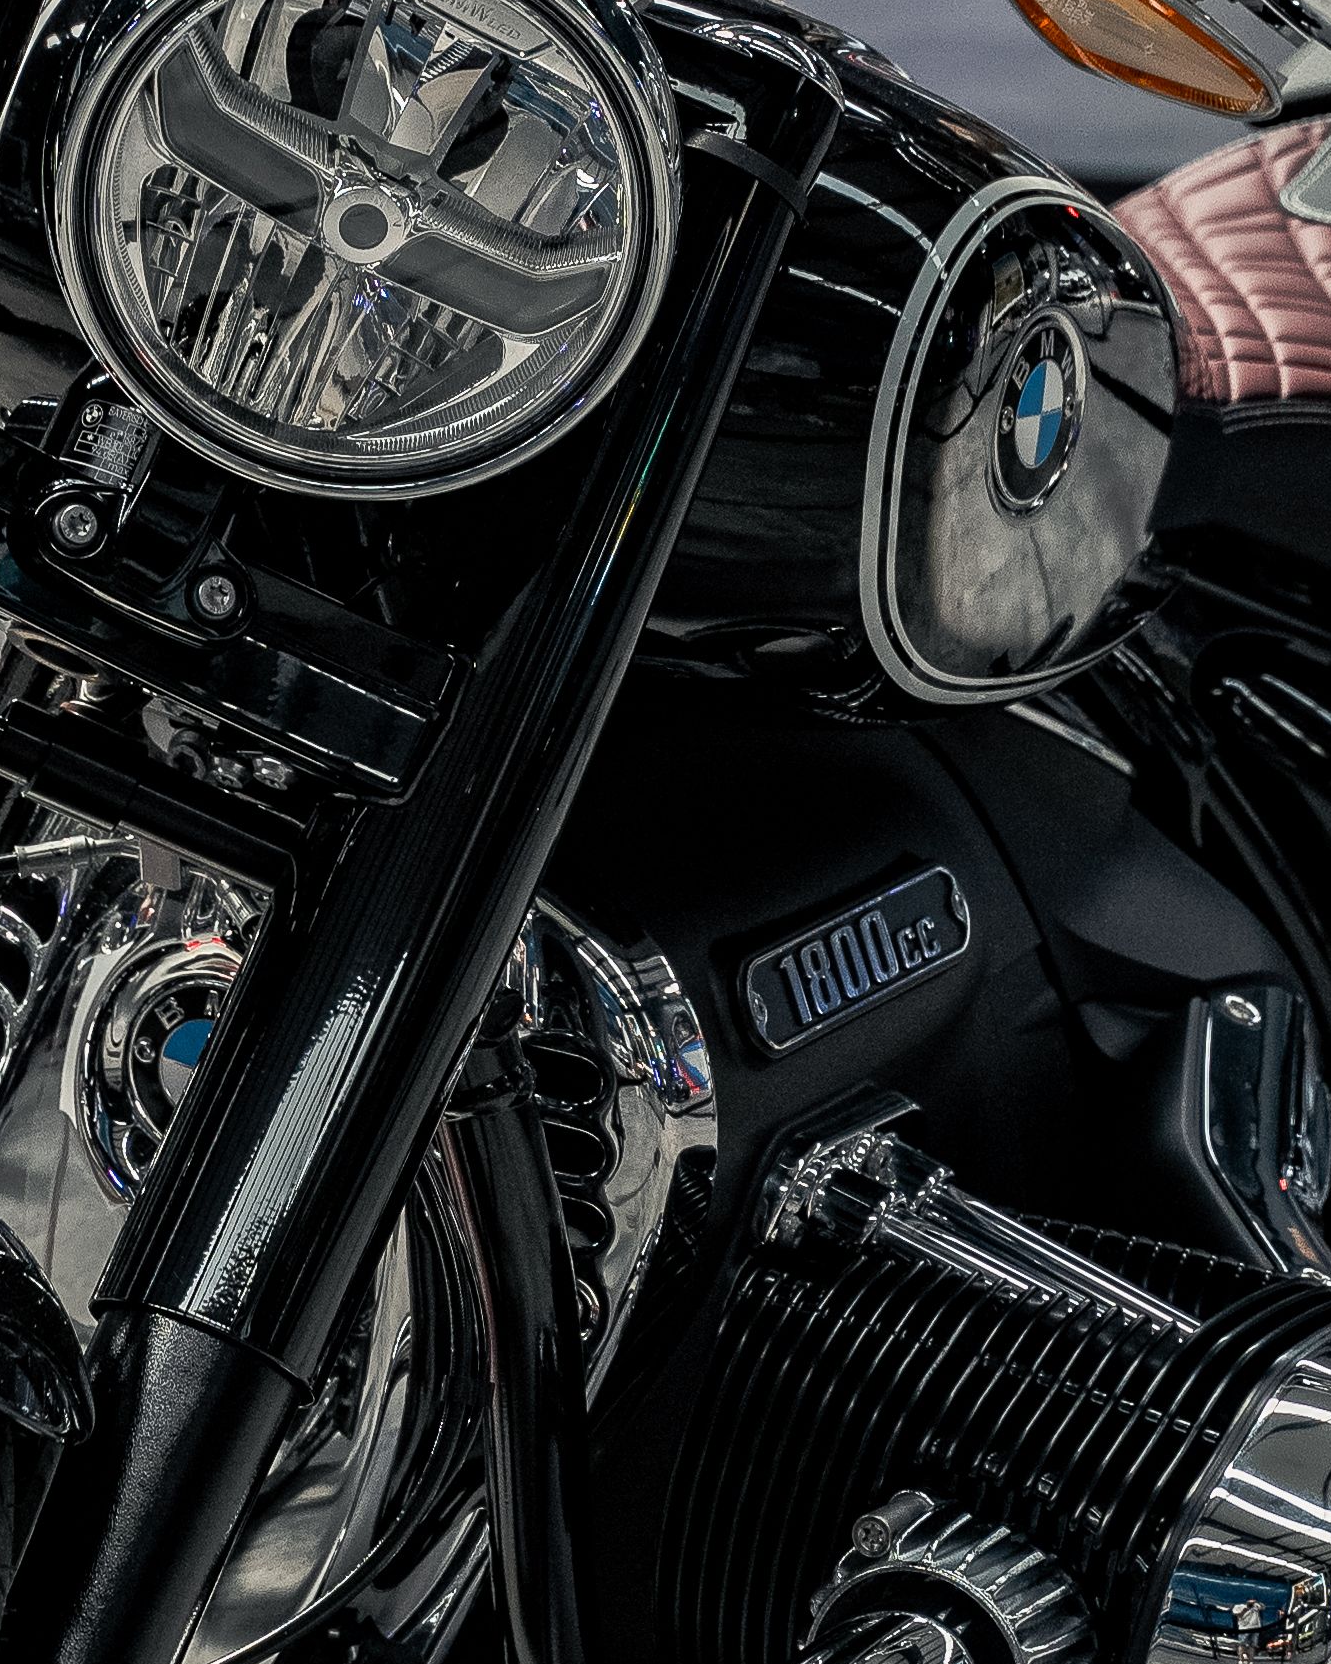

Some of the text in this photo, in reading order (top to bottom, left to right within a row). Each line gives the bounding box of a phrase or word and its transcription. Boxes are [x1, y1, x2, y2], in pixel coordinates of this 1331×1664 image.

[486, 18, 522, 41] LED
[1011, 329, 1075, 391] BMW
[778, 910, 942, 1025] 1800cc
